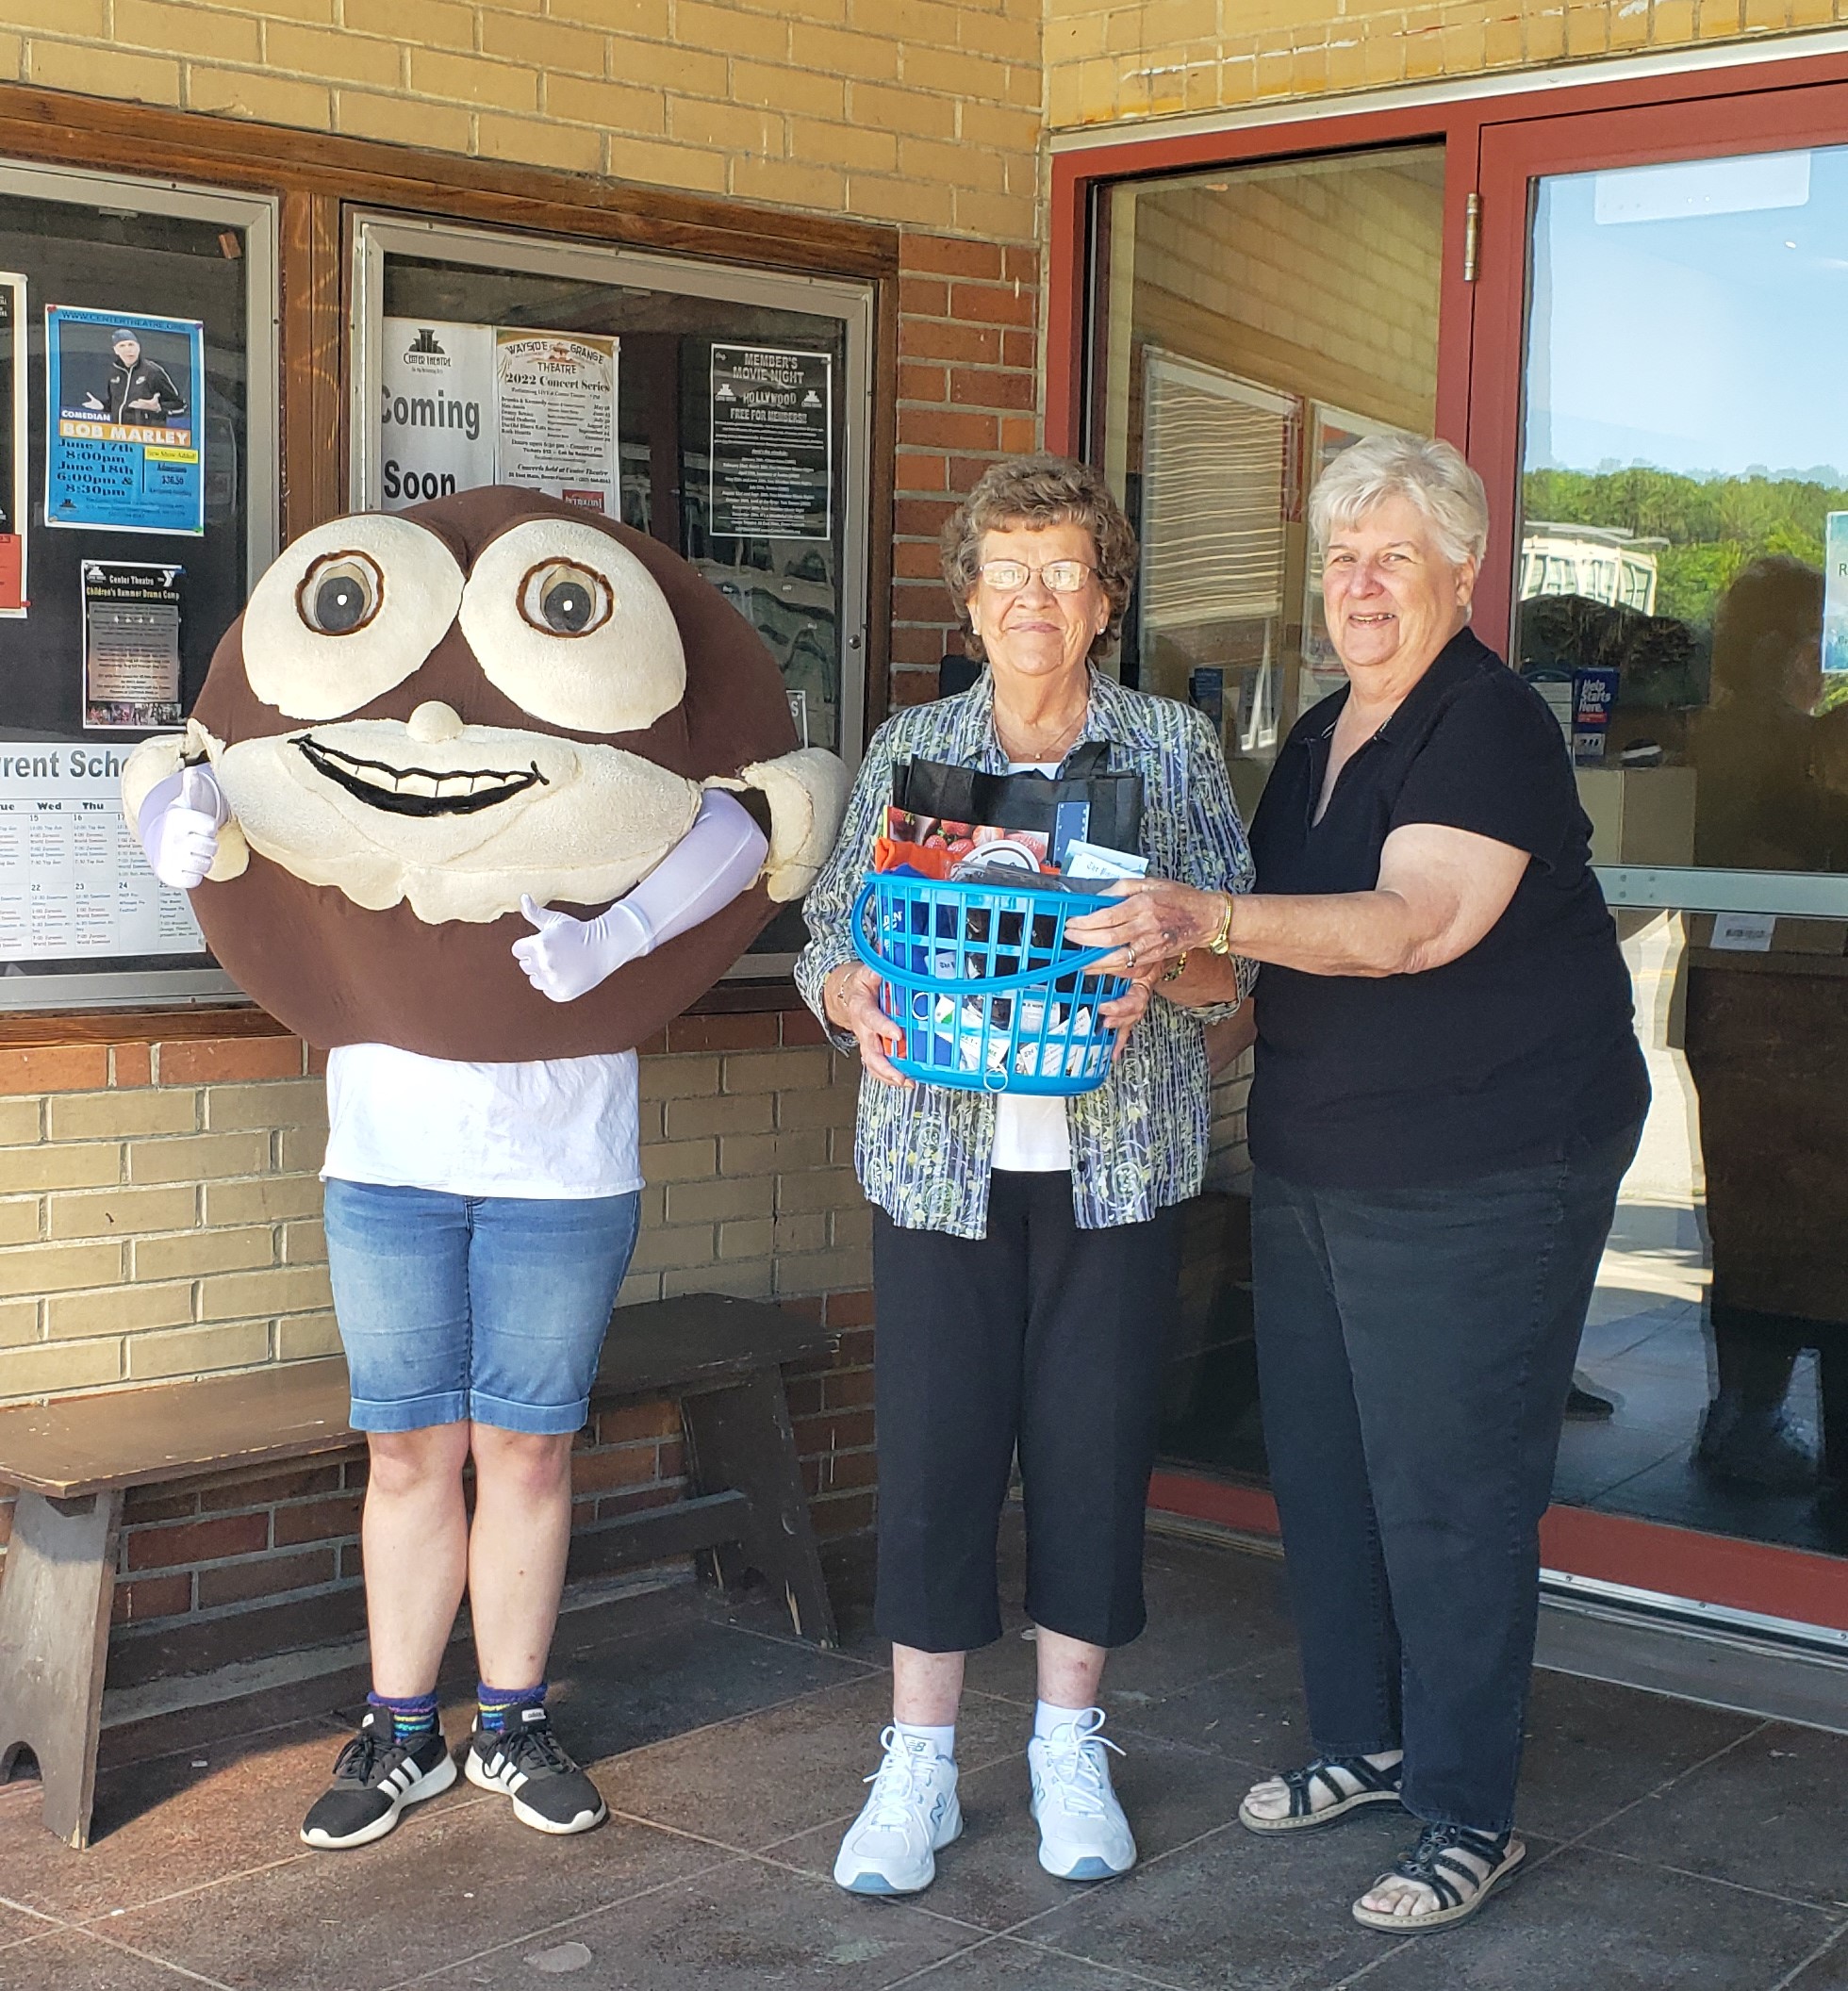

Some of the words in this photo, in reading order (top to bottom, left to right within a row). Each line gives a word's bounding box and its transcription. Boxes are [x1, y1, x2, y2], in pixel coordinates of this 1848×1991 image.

[505, 341, 548, 354] WAYSIDE
[569, 343, 603, 364] GRANGE
[537, 362, 577, 374] THEATRE
[744, 353, 798, 369] MEMBER'S
[733, 366, 767, 381] MOVIE
[770, 370, 804, 384] NIGHT
[505, 373, 536, 386] 2022
[539, 375, 579, 389] Concert
[581, 380, 611, 392] Series
[743, 390, 797, 405] HOLLYWOOD
[61, 410, 110, 421] COMEDIAN
[730, 408, 750, 420] FREE
[751, 409, 767, 421] FOR
[63, 422, 104, 437] BOB
[110, 426, 189, 445] MARLEY
[58, 438, 93, 450] June
[100, 441, 134, 452] 17th
[65, 451, 124, 464] 8:00pm
[58, 461, 93, 471] June
[100, 464, 134, 475] 18th
[57, 471, 116, 485] 6:00pm
[122, 476, 133, 485] &
[383, 460, 455, 500] Soon
[65, 484, 125, 496] 8:30pm
[0, 750, 59, 778] rent
[37, 801, 62, 811] Wed
[82, 801, 104, 810] Thu
